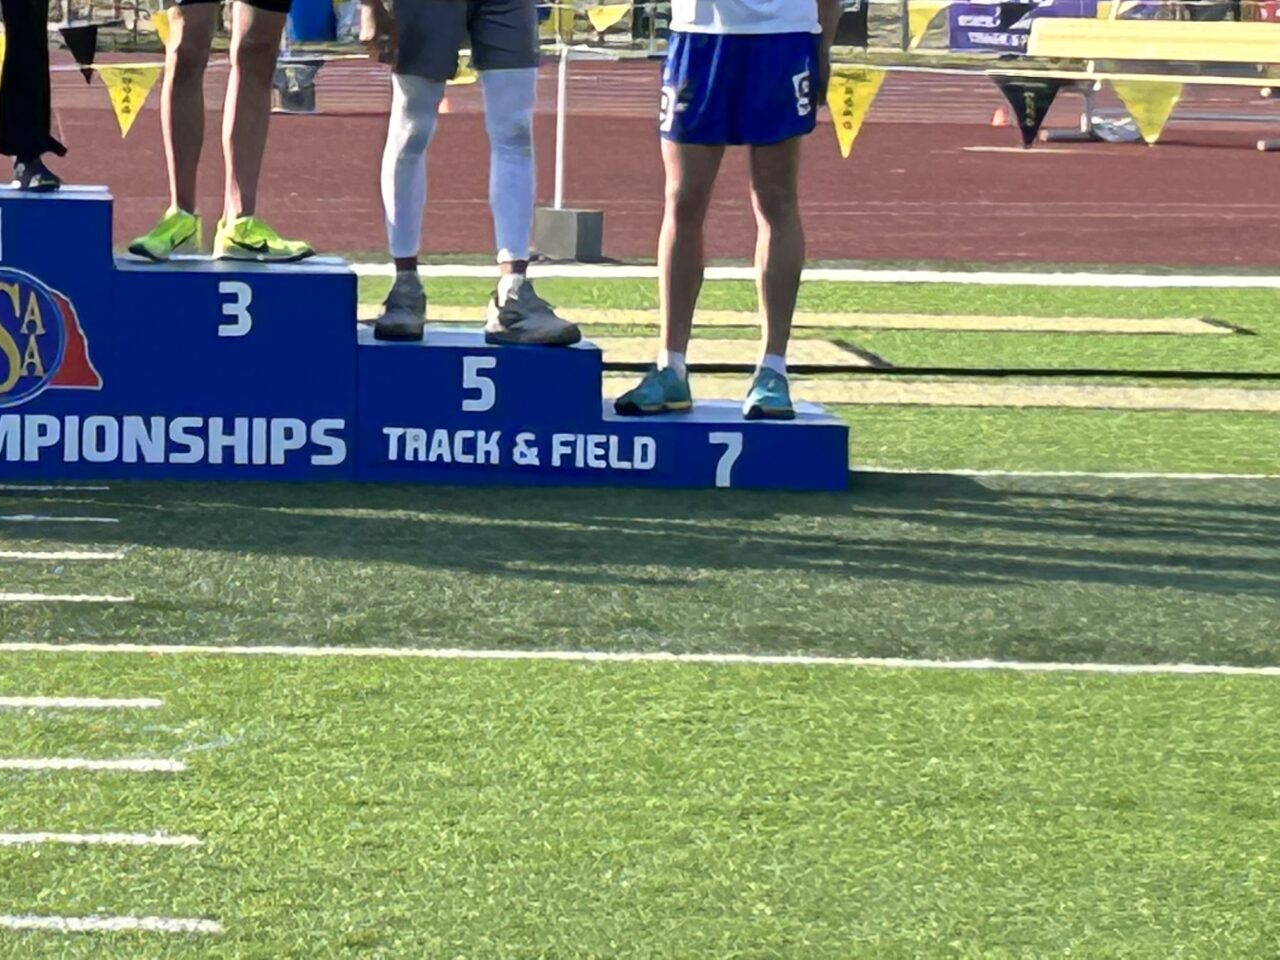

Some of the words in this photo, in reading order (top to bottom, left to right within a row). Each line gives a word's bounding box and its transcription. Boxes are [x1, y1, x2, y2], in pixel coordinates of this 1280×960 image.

[217, 281, 253, 337] 3
[462, 356, 497, 412] 5
[382, 427, 501, 465] TRACK
[512, 433, 540, 466] &
[551, 435, 656, 471] FIELD
[708, 431, 743, 488] 7
